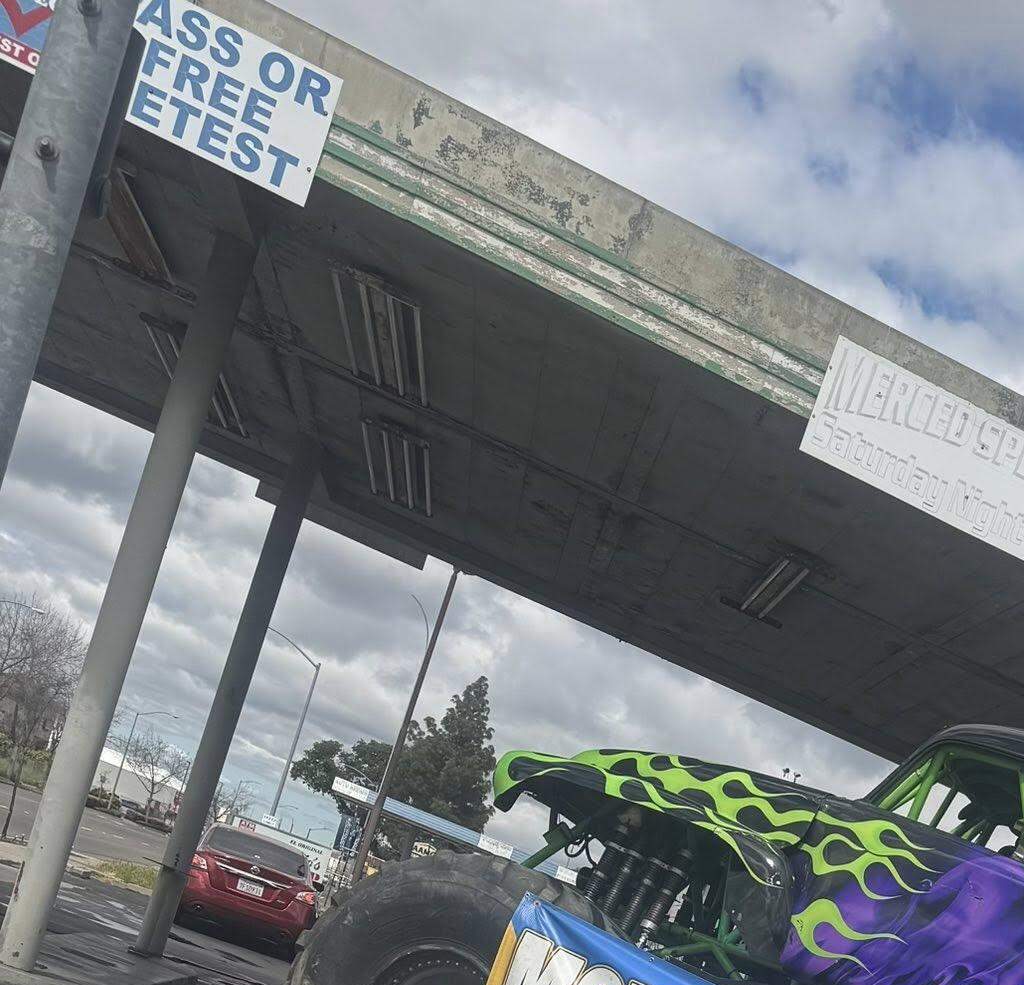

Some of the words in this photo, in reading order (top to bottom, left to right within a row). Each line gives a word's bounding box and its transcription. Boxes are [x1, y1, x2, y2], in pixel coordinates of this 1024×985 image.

[0, 35, 25, 58] ST
[141, 38, 277, 134] FREE
[259, 52, 331, 116] OR
[130, 82, 299, 188] ETEST
[825, 348, 977, 447] MERCED
[811, 411, 949, 513] Saturday
